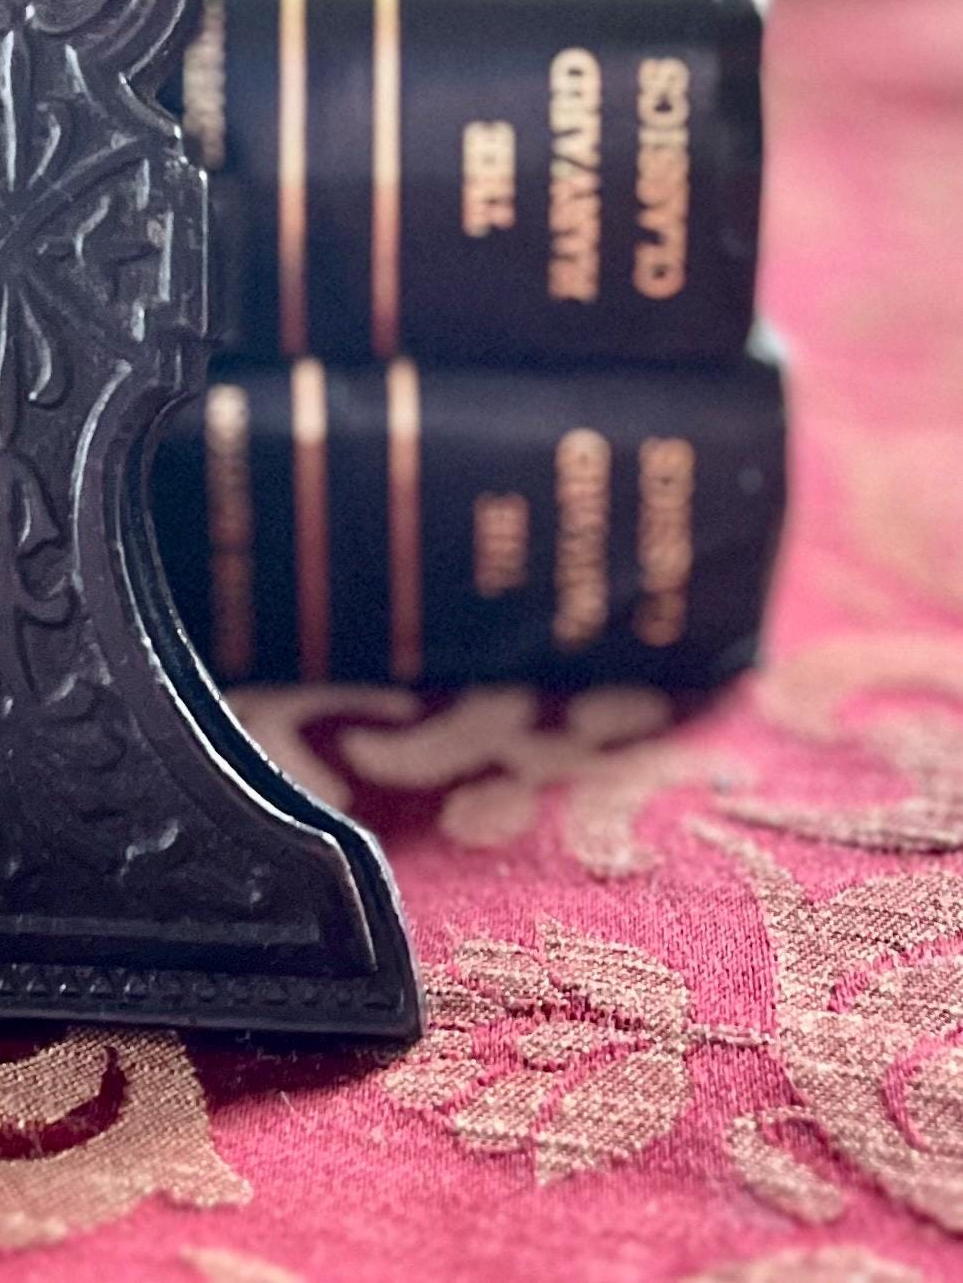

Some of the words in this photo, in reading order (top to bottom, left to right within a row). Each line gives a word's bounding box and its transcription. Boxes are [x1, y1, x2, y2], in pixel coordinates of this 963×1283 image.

[462, 121, 515, 237] THE
[548, 47, 601, 303] HARVARD
[633, 57, 689, 299] CLASSICS
